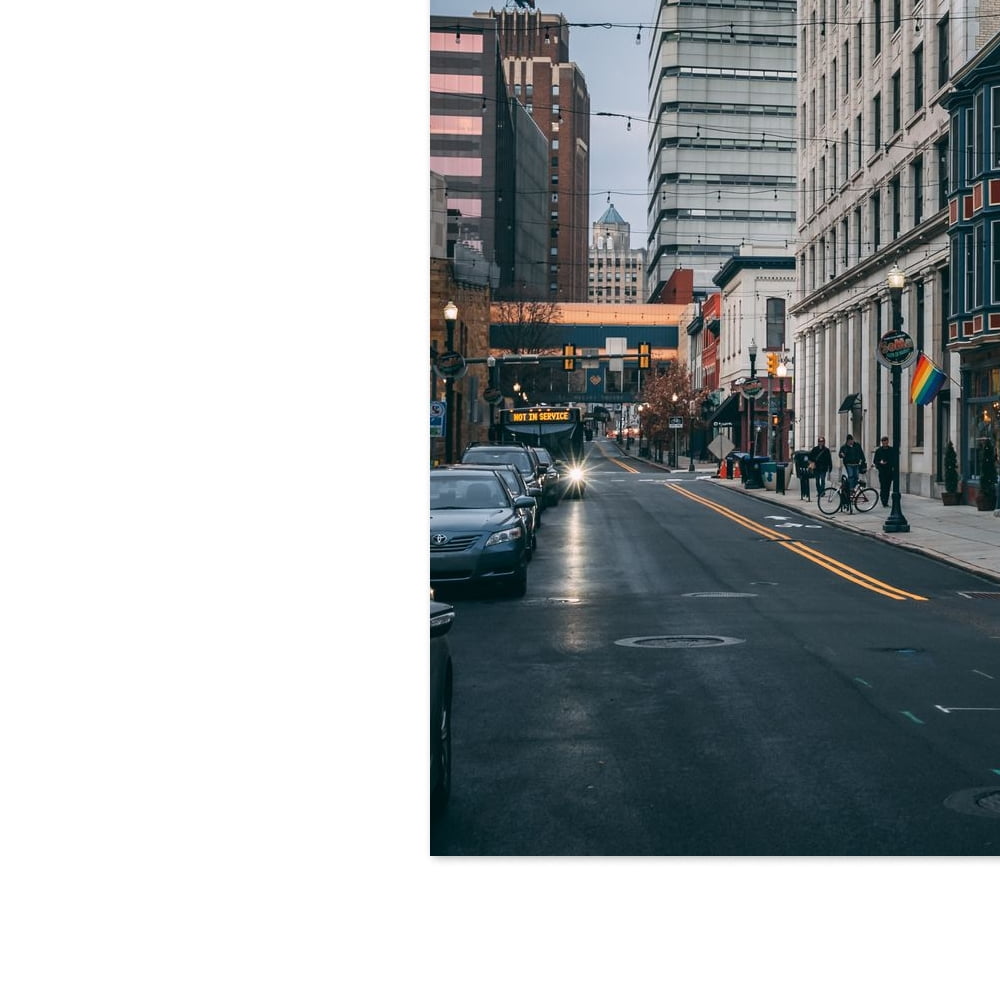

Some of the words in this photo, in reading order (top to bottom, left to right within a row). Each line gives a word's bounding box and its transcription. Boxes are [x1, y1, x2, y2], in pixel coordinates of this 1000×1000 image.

[513, 413, 526, 422] NOT
[528, 413, 538, 421] IN
[539, 412, 569, 421] SERVICE
